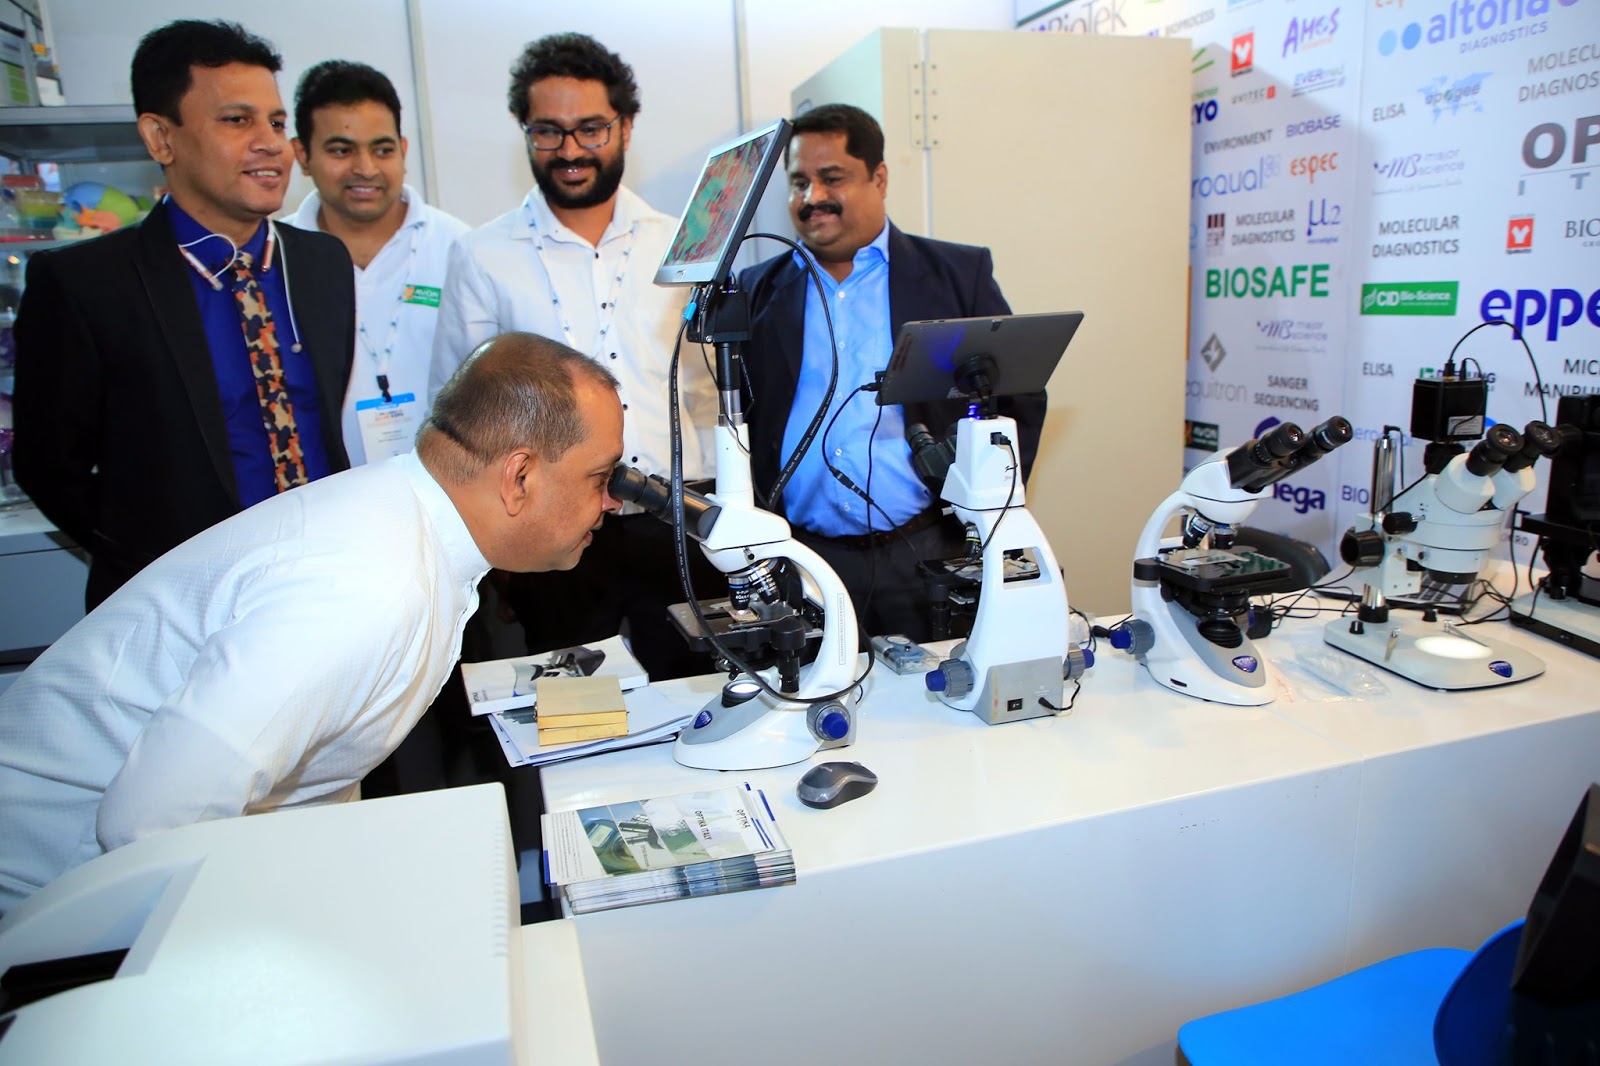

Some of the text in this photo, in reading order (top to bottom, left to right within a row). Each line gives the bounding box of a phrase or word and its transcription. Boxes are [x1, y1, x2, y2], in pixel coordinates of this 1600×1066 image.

[1459, 20, 1548, 53] DIAGNOSTICS
[1373, 102, 1406, 122] ELISA
[1286, 114, 1342, 138] BIOBASE
[1204, 129, 1273, 154] ENVIRONMENT
[1235, 208, 1296, 226] MOLECULAR
[1378, 215, 1460, 235] MOLECULAR
[1231, 229, 1297, 246] DIAGNOSTICS
[1372, 239, 1460, 257] DIAGNOSTICS
[1206, 264, 1330, 298] BIOSAFE
[1362, 361, 1394, 377] ELISA
[1267, 374, 1309, 390] SANGER
[1253, 392, 1320, 412] SEQUENCING
[1272, 482, 1326, 515] ega
[693, 810, 707, 828] OPTIKA
[735, 808, 751, 829] OPTIKA
